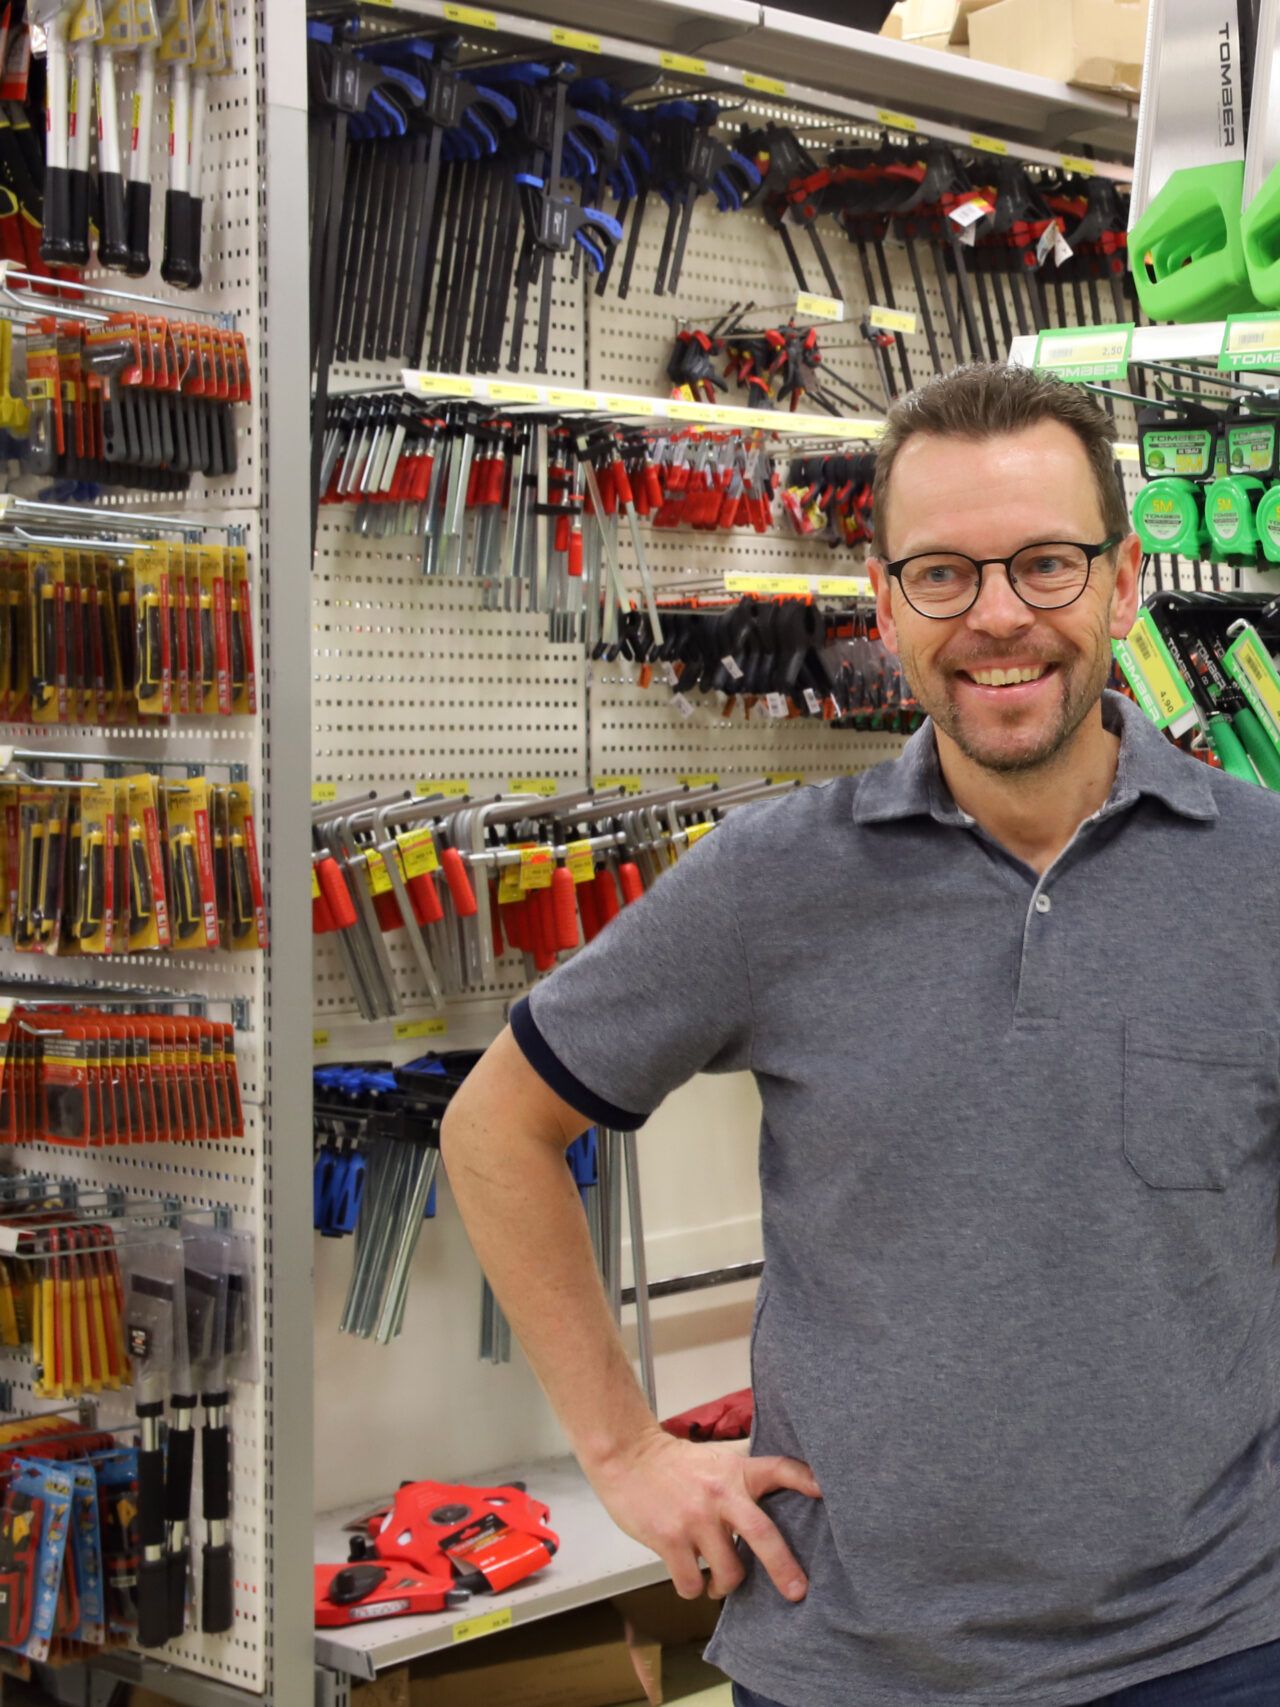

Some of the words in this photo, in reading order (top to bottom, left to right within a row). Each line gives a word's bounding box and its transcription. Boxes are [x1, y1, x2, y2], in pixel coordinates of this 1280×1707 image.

[1219, 22, 1235, 147] TOMBER
[1102, 346, 1123, 356] 2,50
[1176, 456, 1203, 473] 5M
[1152, 499, 1174, 512] 5M
[1218, 497, 1232, 511] 5M
[1167, 637, 1195, 690] TOMBER
[1196, 638, 1226, 690] TOMBER
[1117, 641, 1161, 722] TOMBER
[1160, 690, 1174, 714] 4,90
